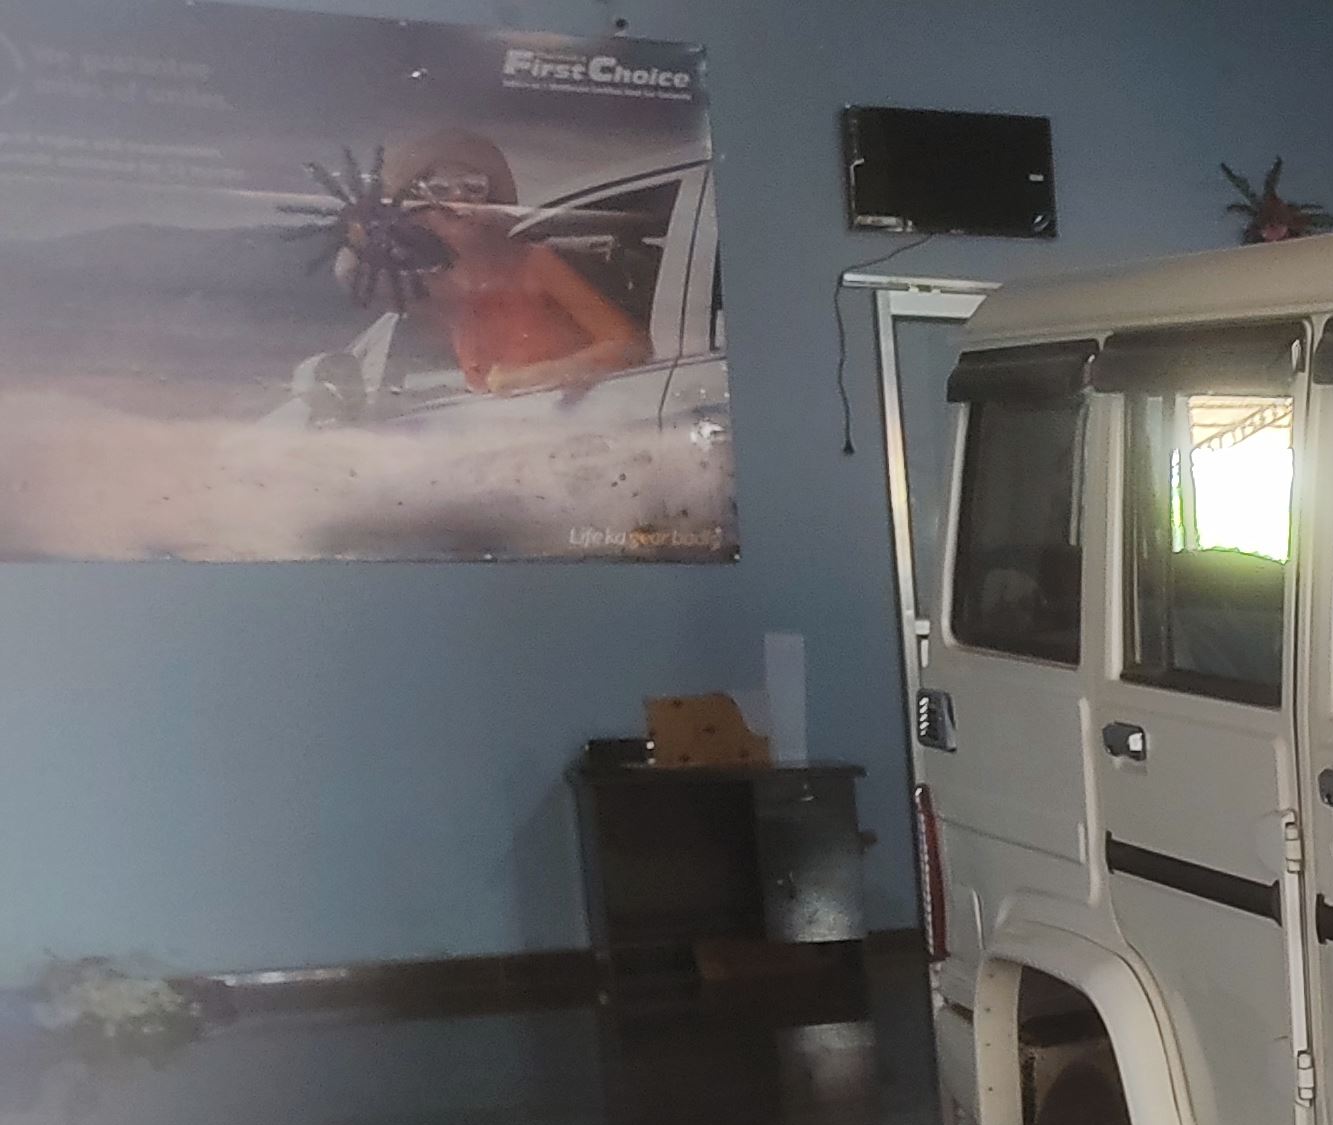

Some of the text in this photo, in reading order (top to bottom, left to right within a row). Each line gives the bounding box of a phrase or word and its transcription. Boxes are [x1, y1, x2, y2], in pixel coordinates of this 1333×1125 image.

[503, 50, 690, 88] First Choice
[569, 526, 602, 548] Life
